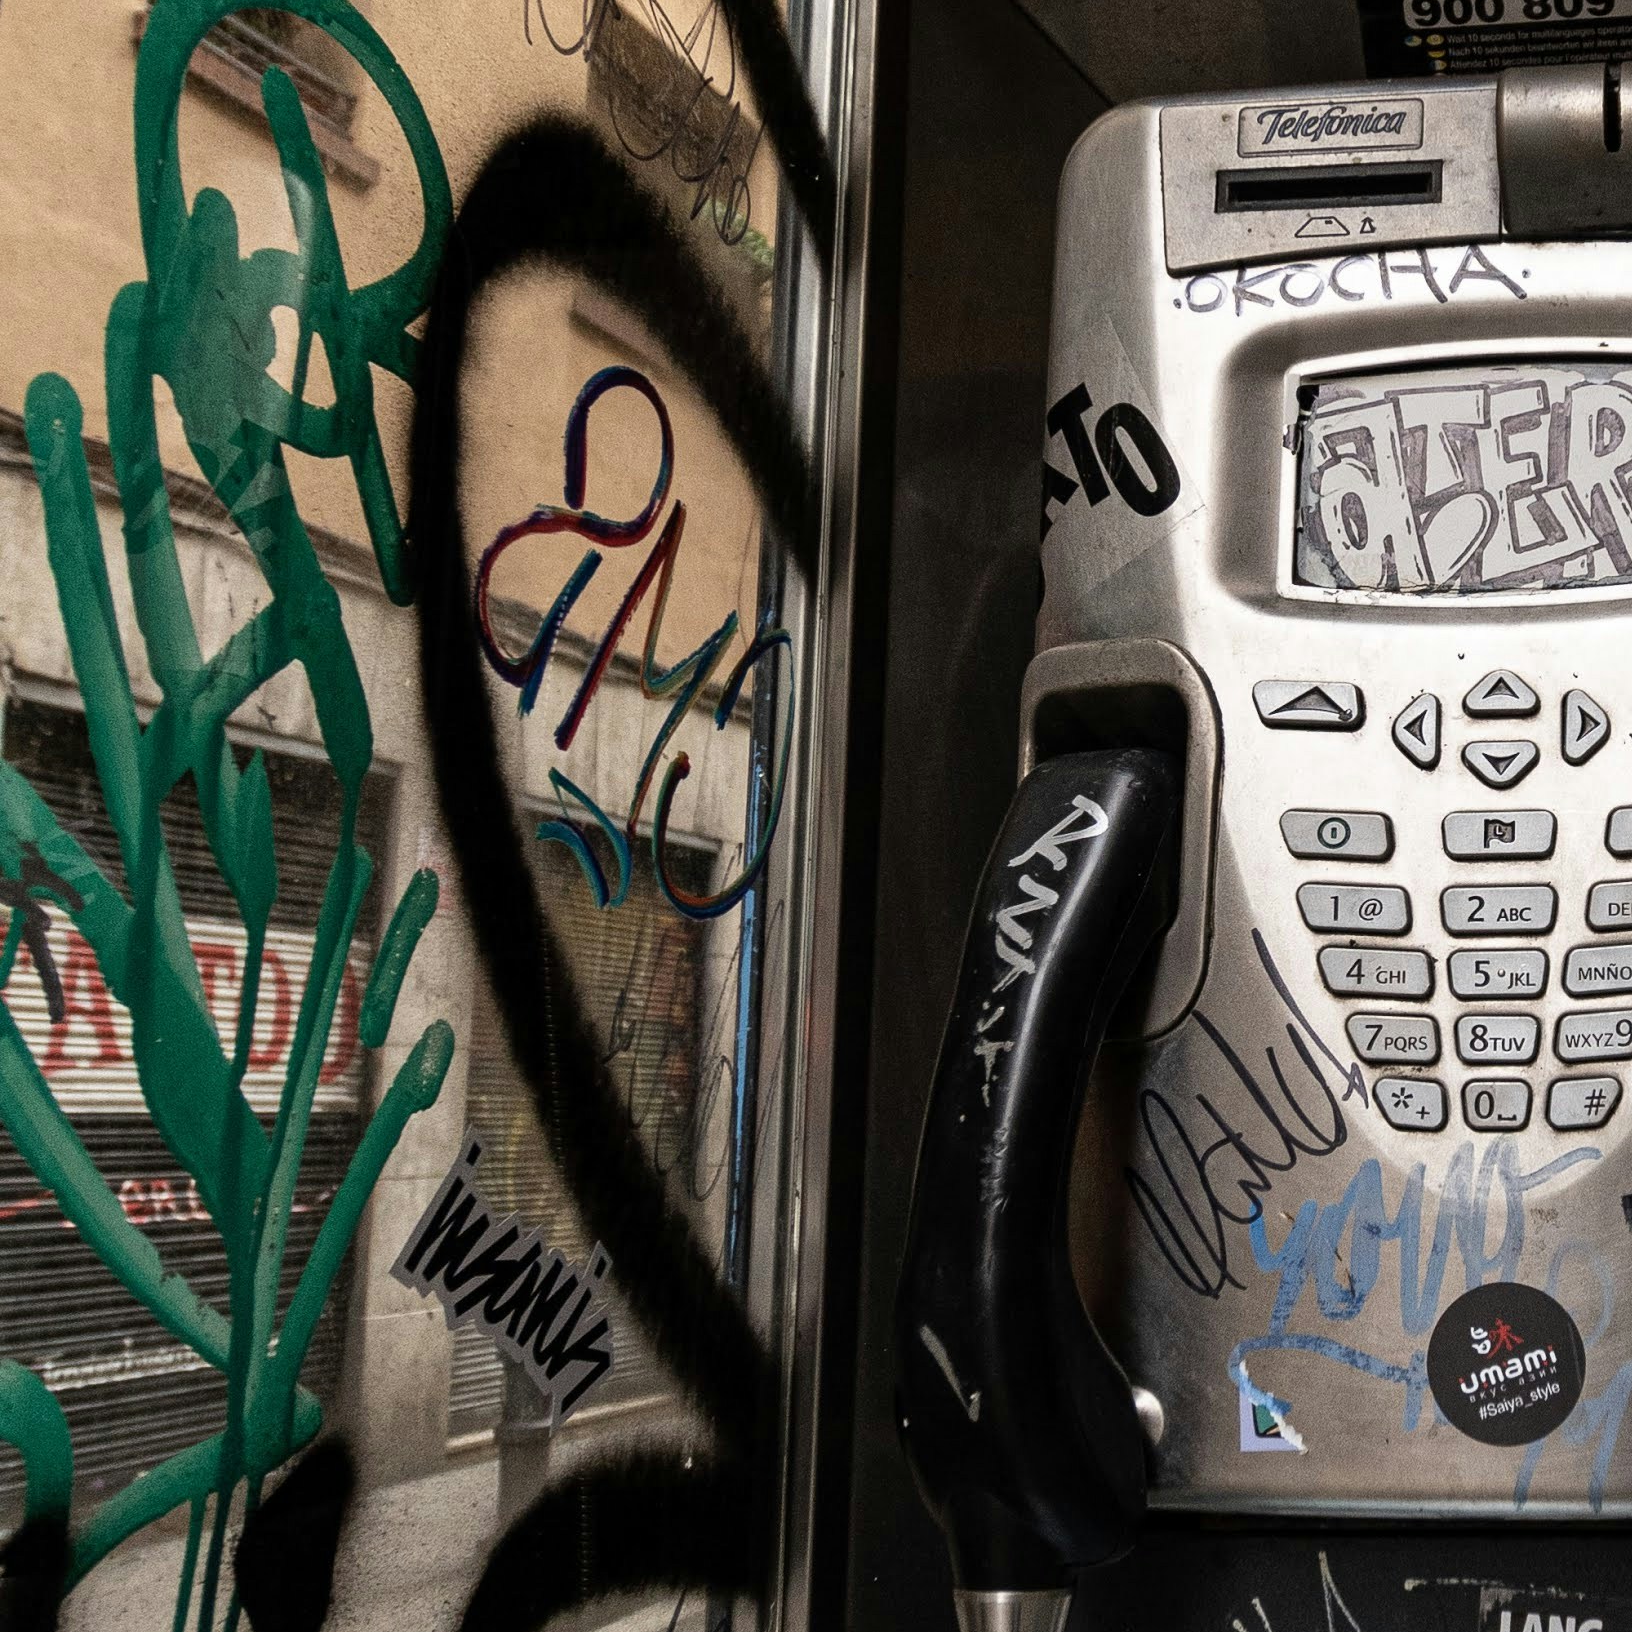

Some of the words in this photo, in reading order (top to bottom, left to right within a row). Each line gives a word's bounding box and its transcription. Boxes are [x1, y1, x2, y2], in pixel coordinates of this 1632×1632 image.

[1330, 895, 1341, 921] 1
[1357, 897, 1384, 922] @
[1466, 895, 1486, 923] 2
[1496, 904, 1532, 923] ABC
[1346, 958, 1366, 985] 4
[1376, 967, 1407, 985] GHI
[1474, 960, 1491, 988] 5
[1507, 969, 1536, 989] JKL
[1577, 961, 1632, 982] MNÑO
[1364, 1024, 1384, 1052] 7
[1384, 1033, 1428, 1054] PQRS
[1468, 1024, 1489, 1053] 8
[1488, 1034, 1525, 1052] TUV
[1565, 1030, 1615, 1049] WXYZ
[1473, 1089, 1494, 1119] 0
[1458, 1344, 1558, 1394] umami
[1469, 1384, 1507, 1404] вкус
[1479, 1382, 1561, 1421] #Saiya_style
